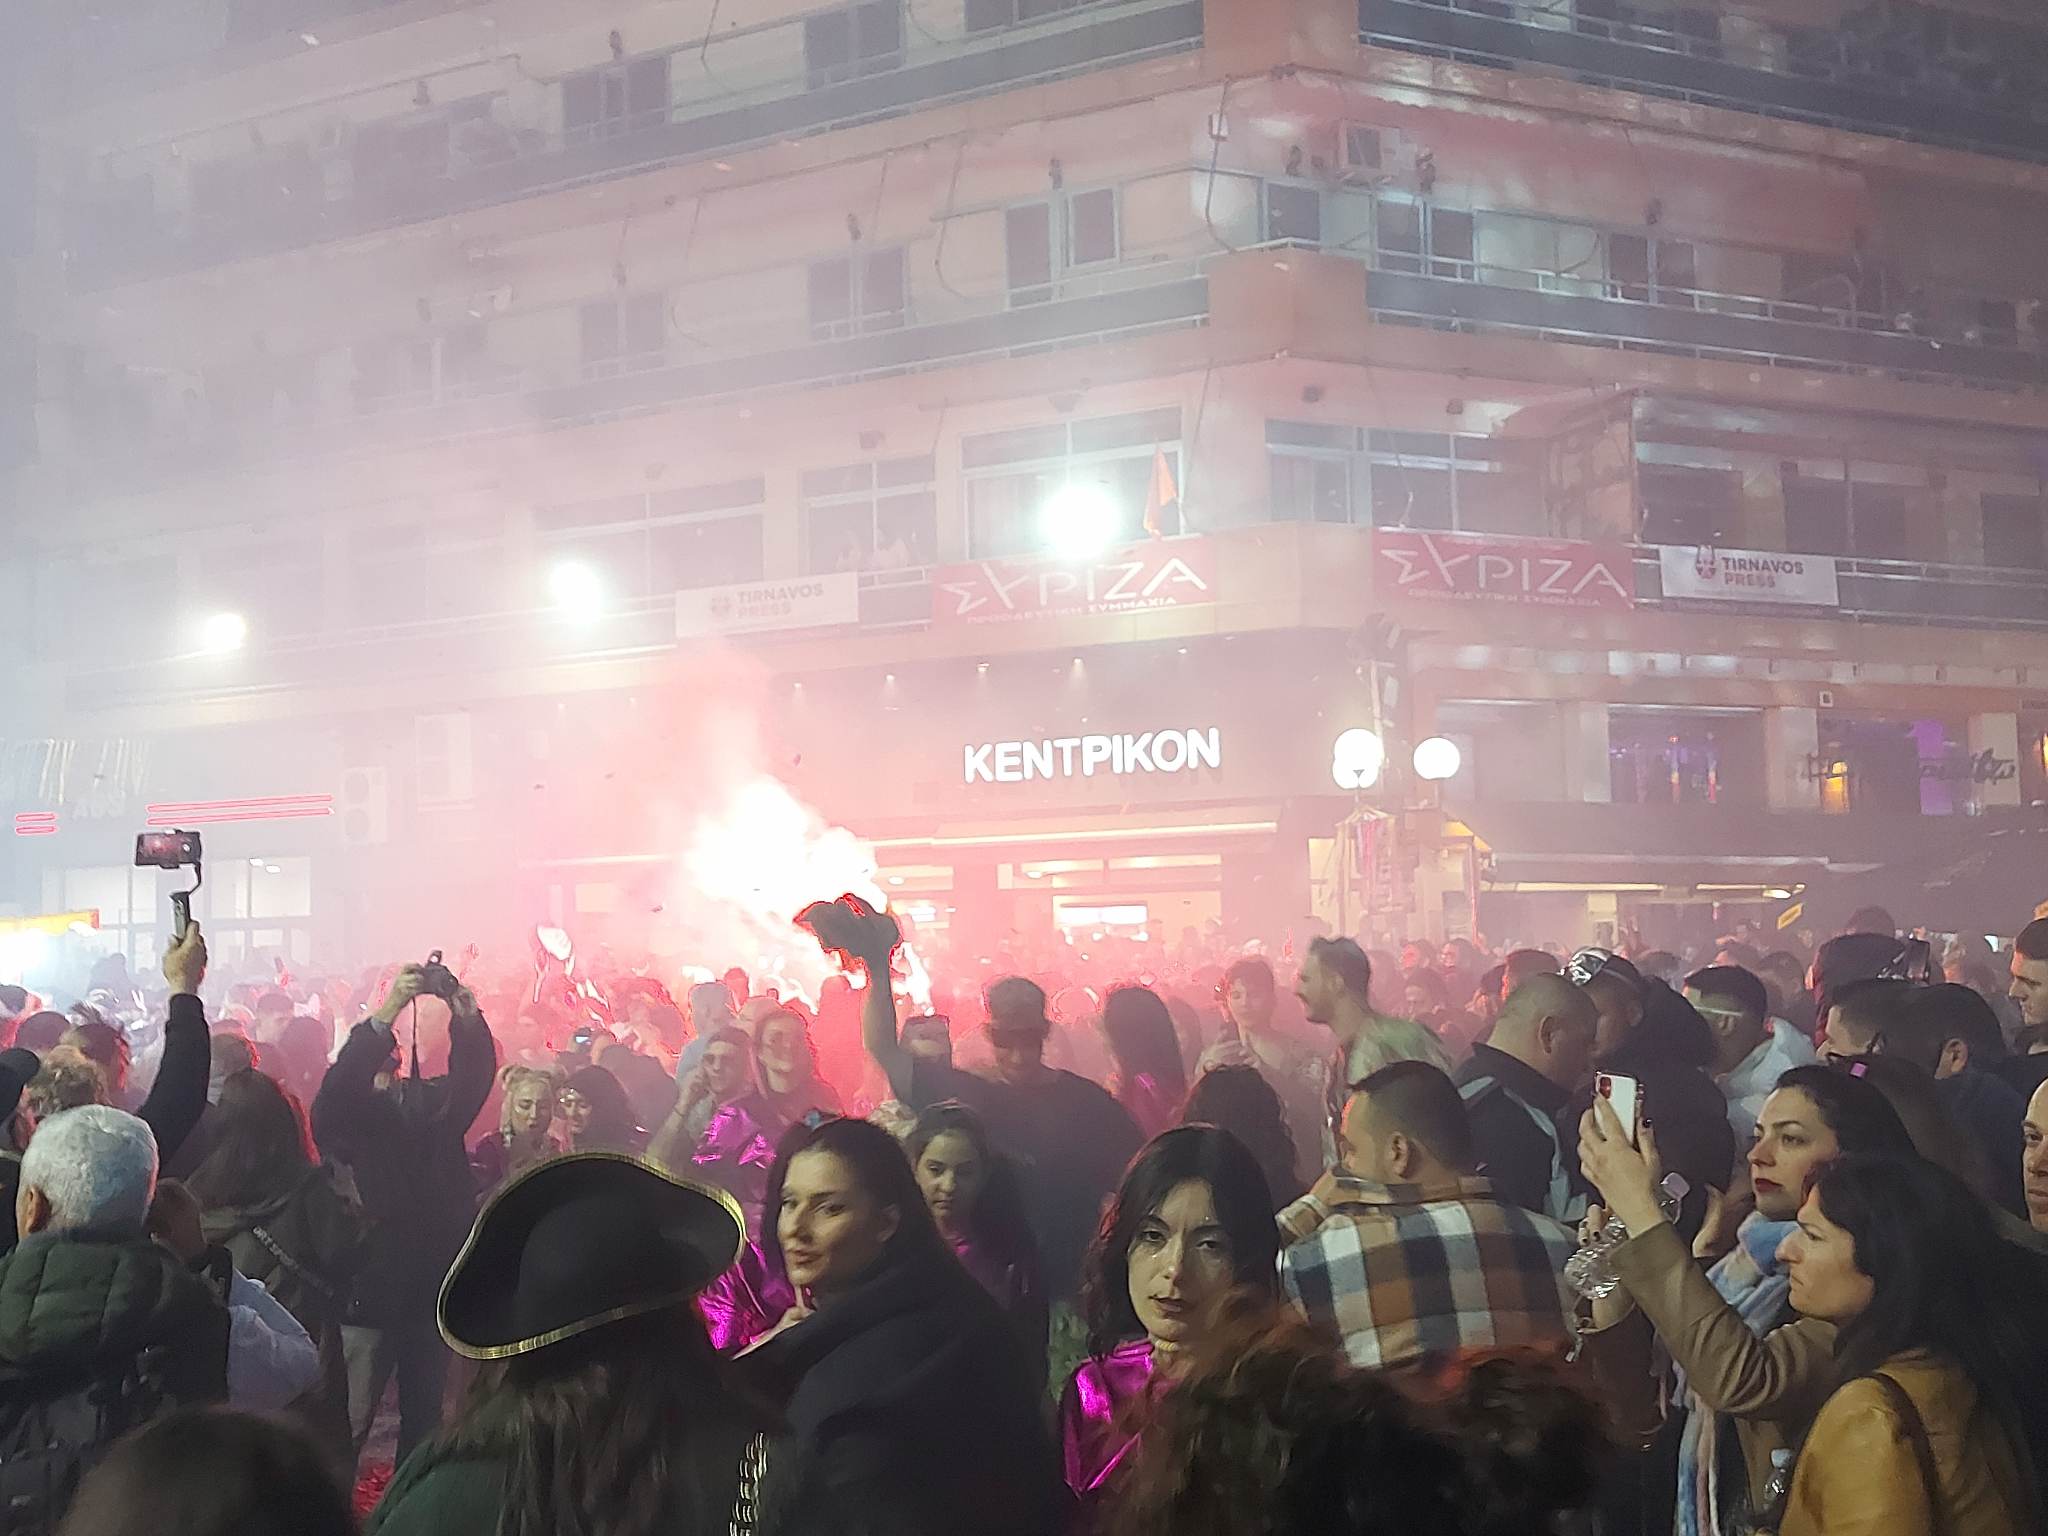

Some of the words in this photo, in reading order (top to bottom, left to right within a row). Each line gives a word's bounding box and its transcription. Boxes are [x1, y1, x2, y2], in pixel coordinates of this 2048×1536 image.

[1381, 534, 1628, 597] ΣΥΡΙΖΑ
[1721, 557, 1804, 575] TIRNAVOS
[1724, 572, 1776, 588] PRESS
[737, 583, 824, 604] TIRNAVOS
[941, 557, 1208, 615] ΣΥΡΙΖΑ
[964, 727, 1221, 783] ΚΕΝΤΡΙΚΟΝ
